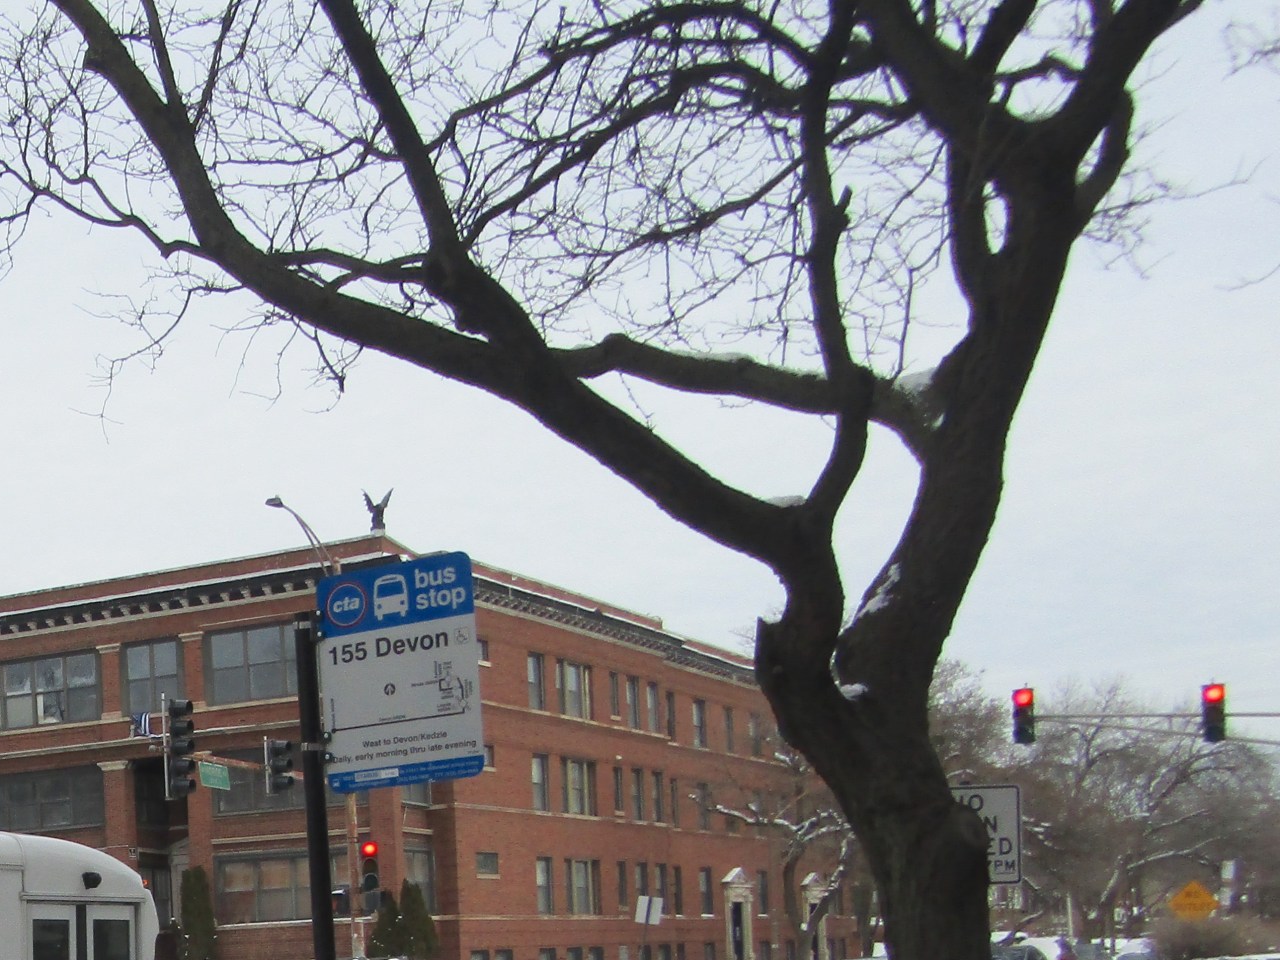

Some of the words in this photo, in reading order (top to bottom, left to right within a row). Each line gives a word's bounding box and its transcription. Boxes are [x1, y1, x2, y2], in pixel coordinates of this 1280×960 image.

[414, 566, 456, 589] bus
[332, 596, 360, 613] cta
[415, 587, 467, 610] stop
[328, 641, 367, 666] 155
[375, 630, 449, 658] Devon
[355, 752, 374, 761] early
[376, 748, 408, 758] morning
[410, 746, 426, 754] thru
[428, 744, 443, 752] late
[444, 740, 477, 750] evening
[362, 739, 381, 748] West
[383, 738, 391, 746] to
